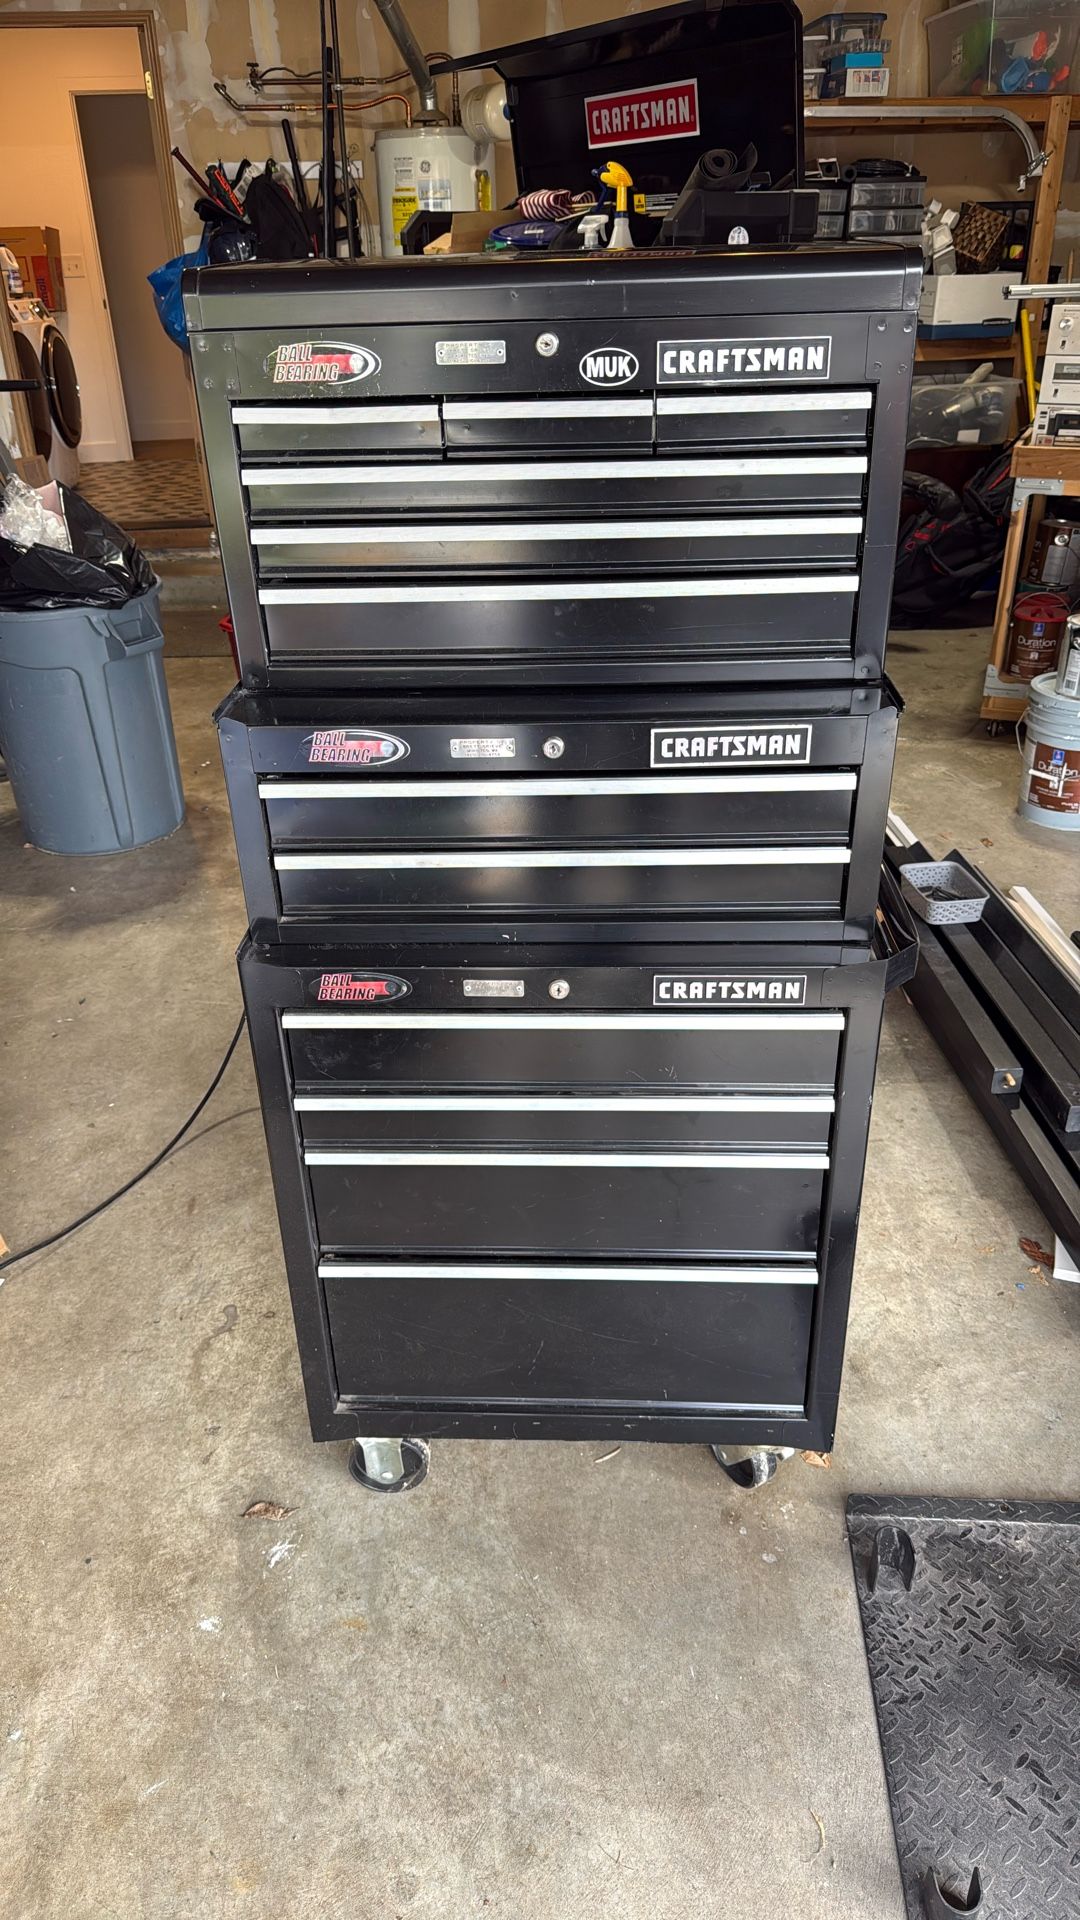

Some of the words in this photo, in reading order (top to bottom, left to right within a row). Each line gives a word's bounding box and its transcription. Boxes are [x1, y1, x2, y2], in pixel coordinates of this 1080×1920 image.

[592, 95, 690, 136] CRAFTSMAN
[276, 343, 313, 363] BALL
[663, 346, 825, 374] CRAFTSMAN
[273, 362, 340, 384] BEARING
[585, 356, 632, 378] MUK
[1018, 634, 1057, 647] Duration
[312, 731, 347, 747] BALL
[661, 734, 802, 758] CRAFTSMAN
[309, 747, 371, 764] BEARING
[1038, 760, 1079, 777] Duraton
[320, 973, 353, 987] BALL
[659, 980, 800, 999] CRAFTSMAN
[317, 987, 376, 1001] BEARING
